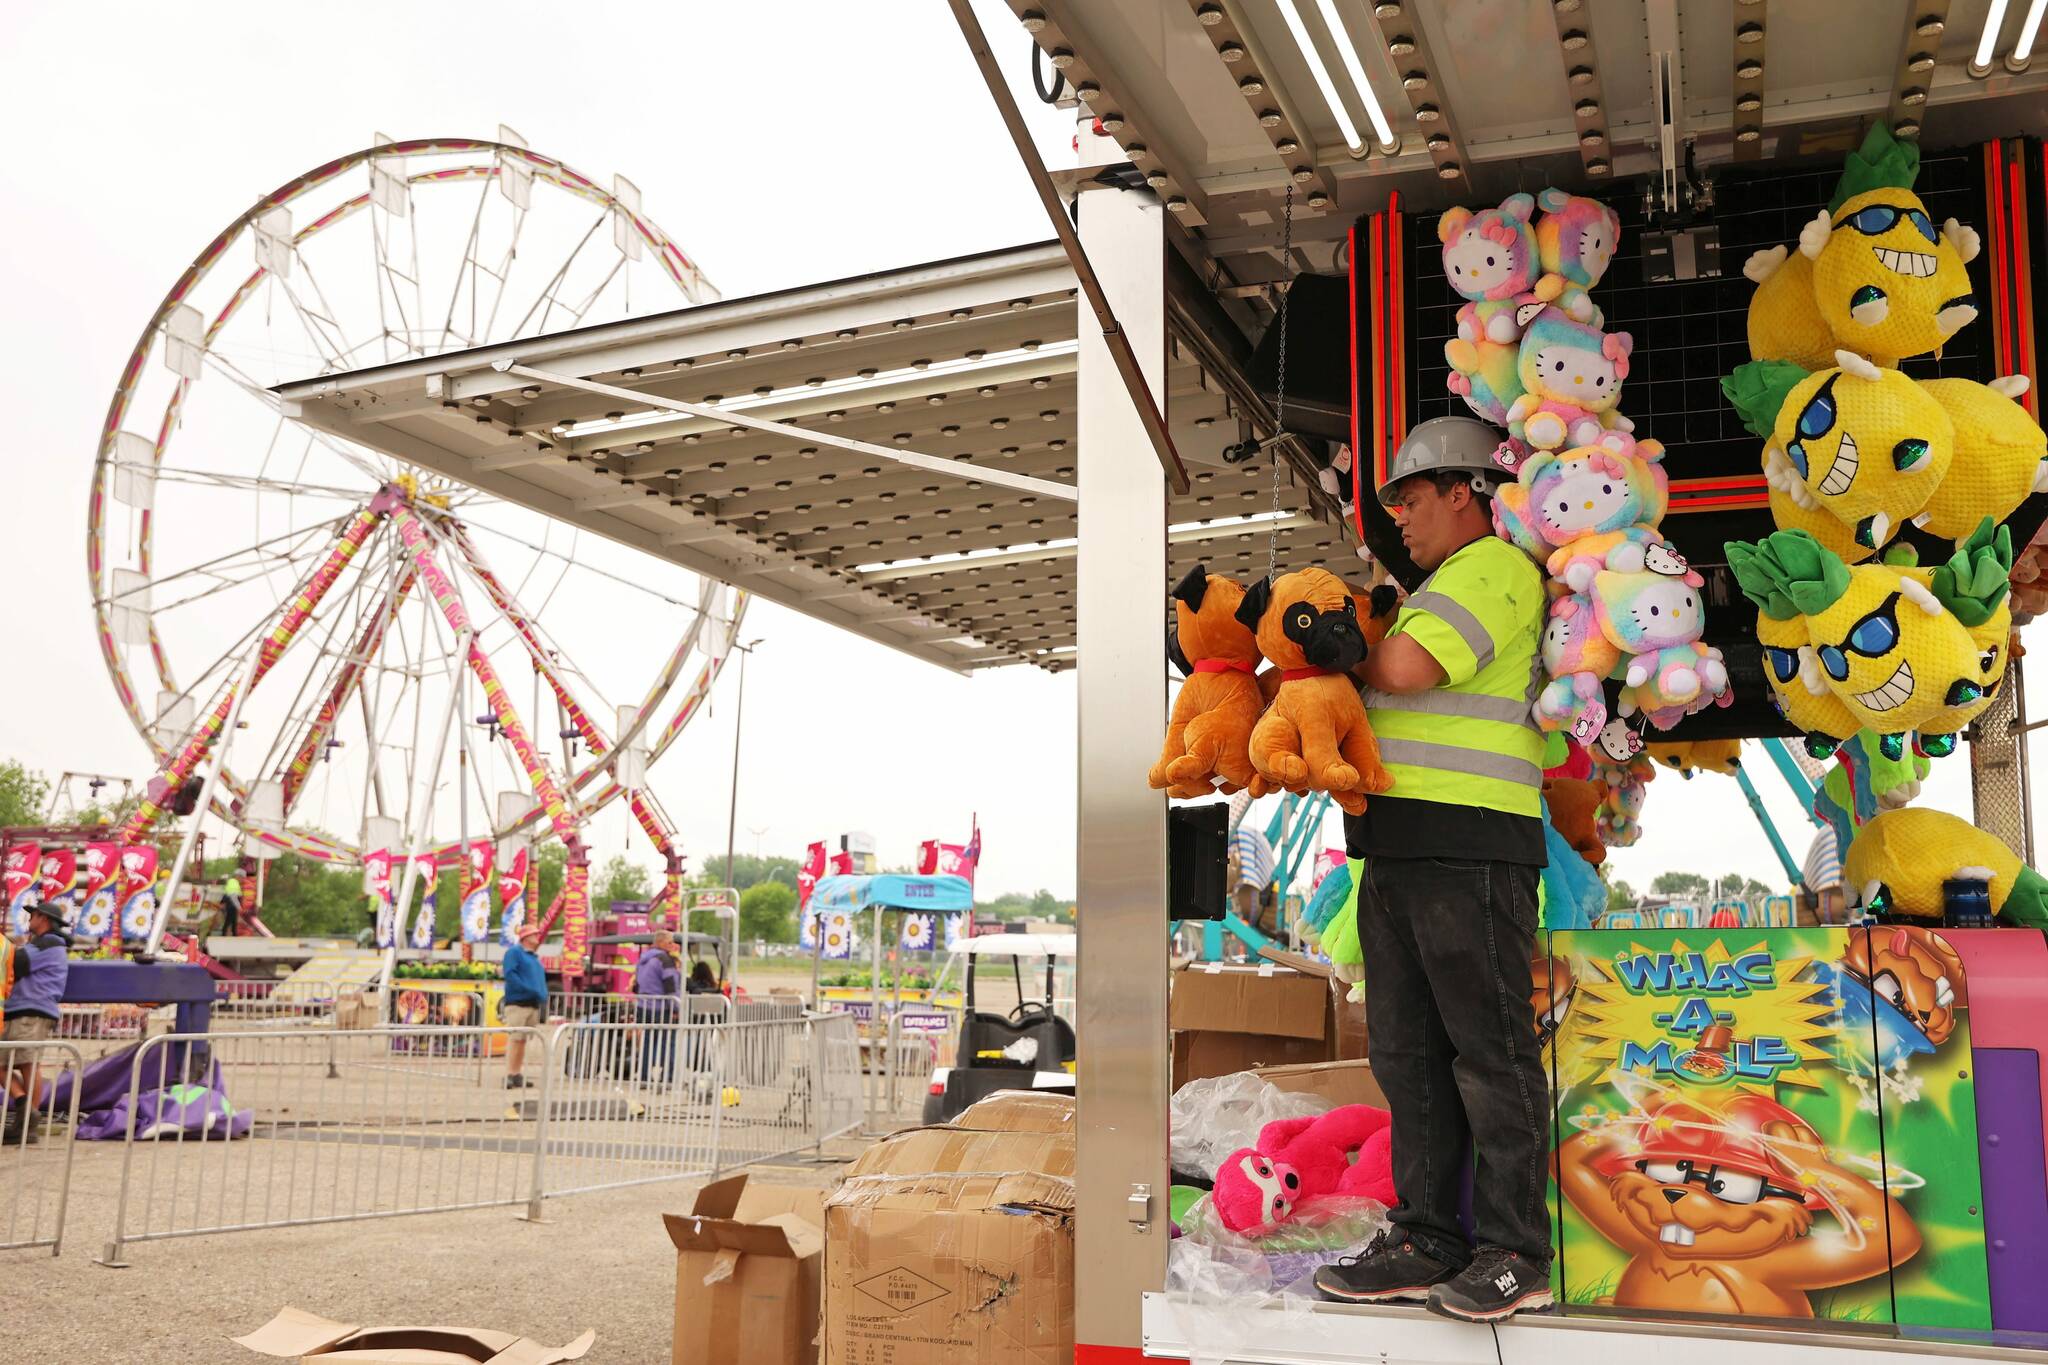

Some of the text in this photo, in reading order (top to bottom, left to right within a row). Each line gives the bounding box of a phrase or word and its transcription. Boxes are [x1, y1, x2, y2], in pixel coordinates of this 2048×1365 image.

[905, 884, 935, 897] ENTER
[1616, 951, 1774, 992] WHAC
[903, 1016, 947, 1027] ENTRANCE
[1621, 1036, 1796, 1082] MOLE
[1494, 1270, 1517, 1292] HH
[885, 1334, 913, 1342] CENTRAL
